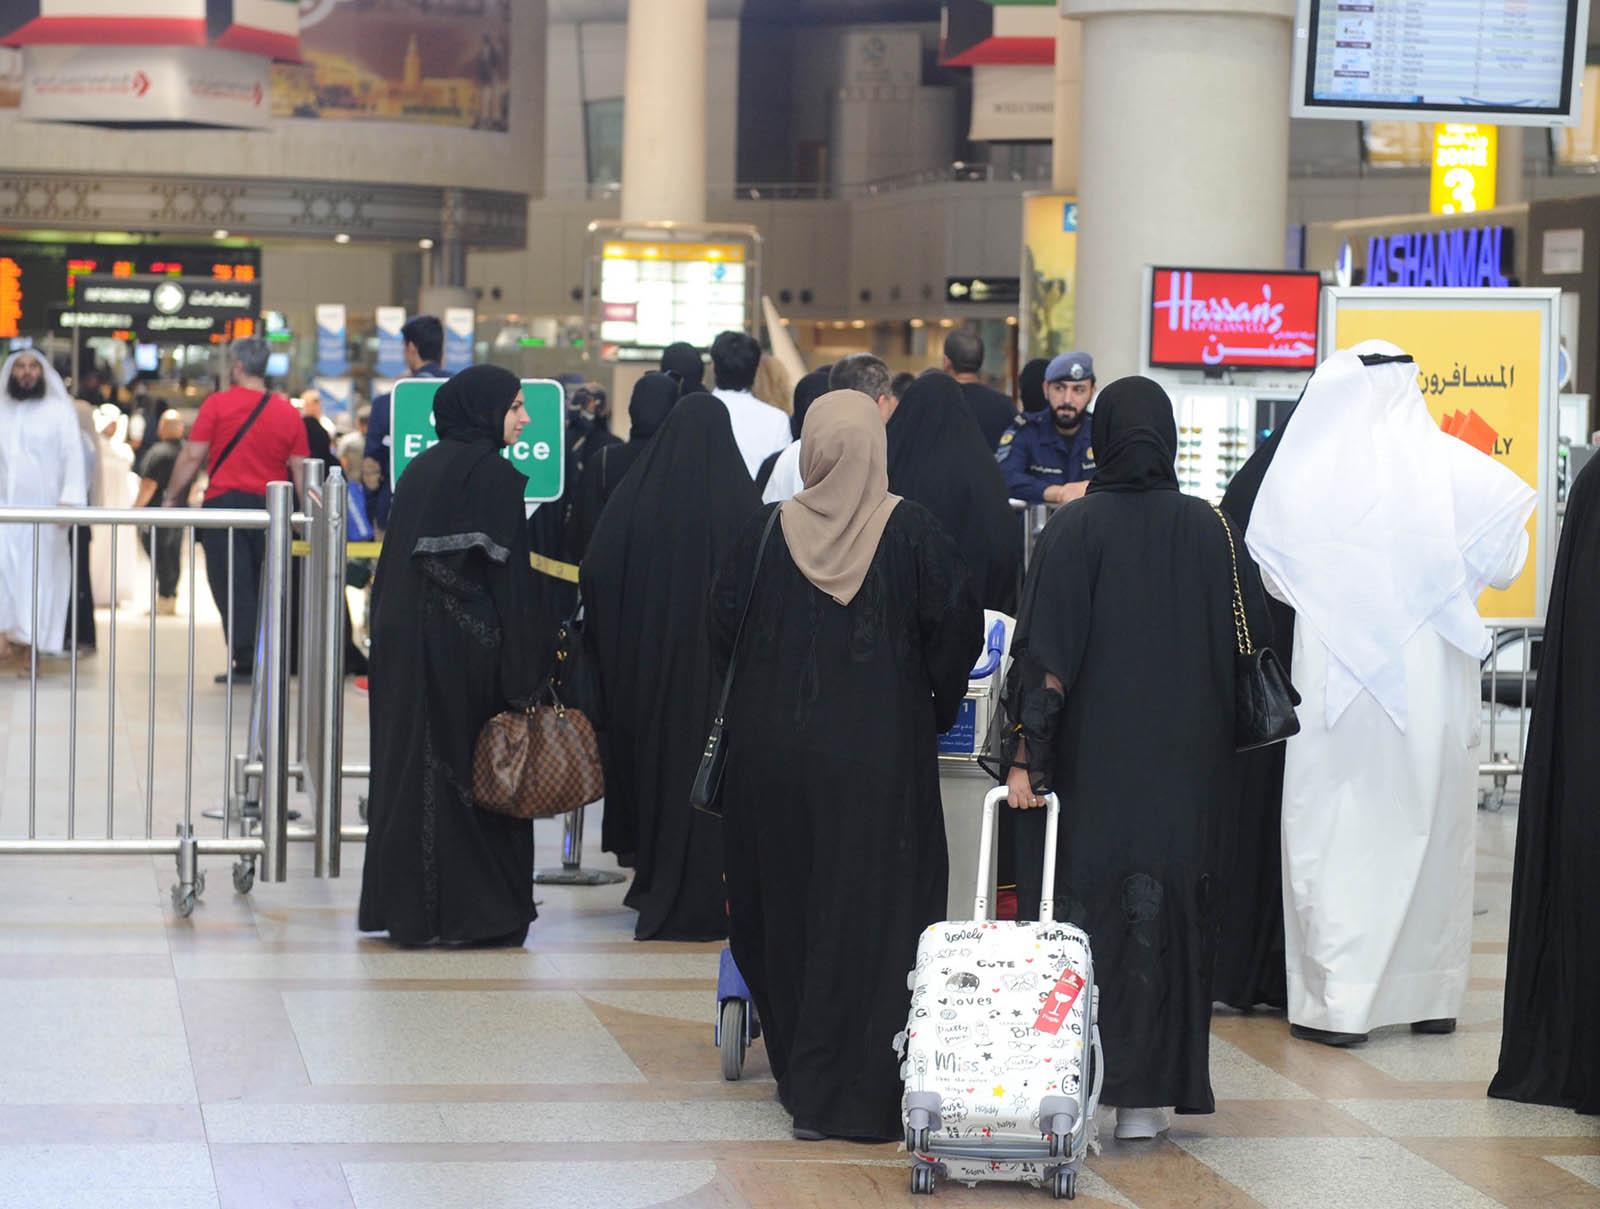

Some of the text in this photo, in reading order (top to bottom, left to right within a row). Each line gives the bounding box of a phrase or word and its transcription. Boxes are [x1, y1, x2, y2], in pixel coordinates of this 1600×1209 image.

[1443, 168, 1476, 213] 3
[1361, 225, 1510, 287] JASHANMAL
[1493, 438, 1513, 455] LY
[976, 960, 1015, 968] CUTE
